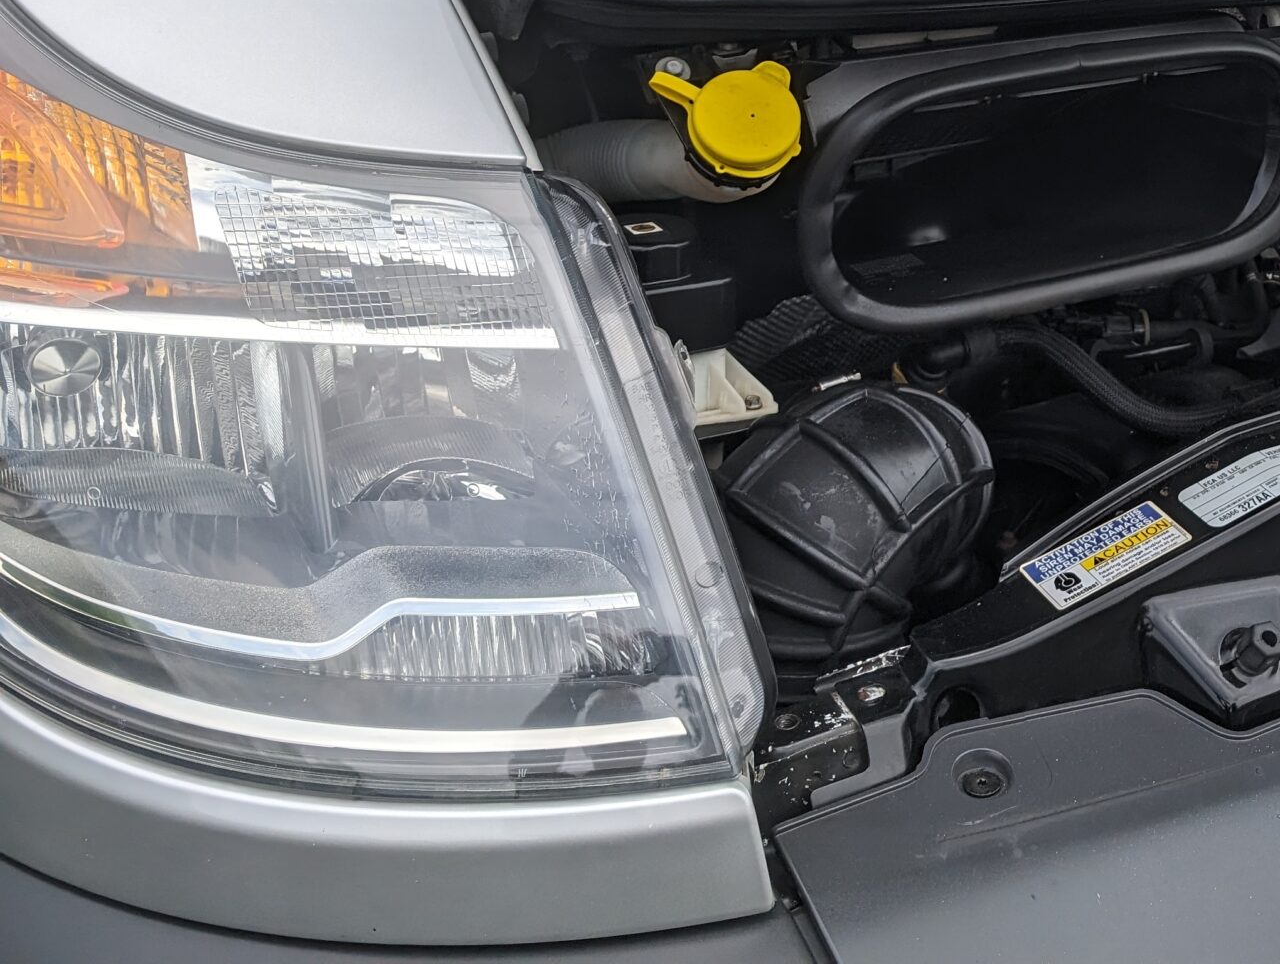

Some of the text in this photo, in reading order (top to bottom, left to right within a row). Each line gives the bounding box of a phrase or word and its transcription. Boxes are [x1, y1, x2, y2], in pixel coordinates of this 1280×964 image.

[1202, 464, 1241, 487] FCA US LLC
[1238, 491, 1272, 513] 327AA
[1034, 507, 1142, 567] ACTIVATION OF THIS
[1038, 514, 1146, 573] SIREN MAY DAMAGE
[1040, 515, 1155, 579] UNPROTECTED EARS!
[1104, 519, 1169, 558] CAUTION
[1064, 582, 1099, 603] Protection!
[1067, 583, 1084, 594] Wear
